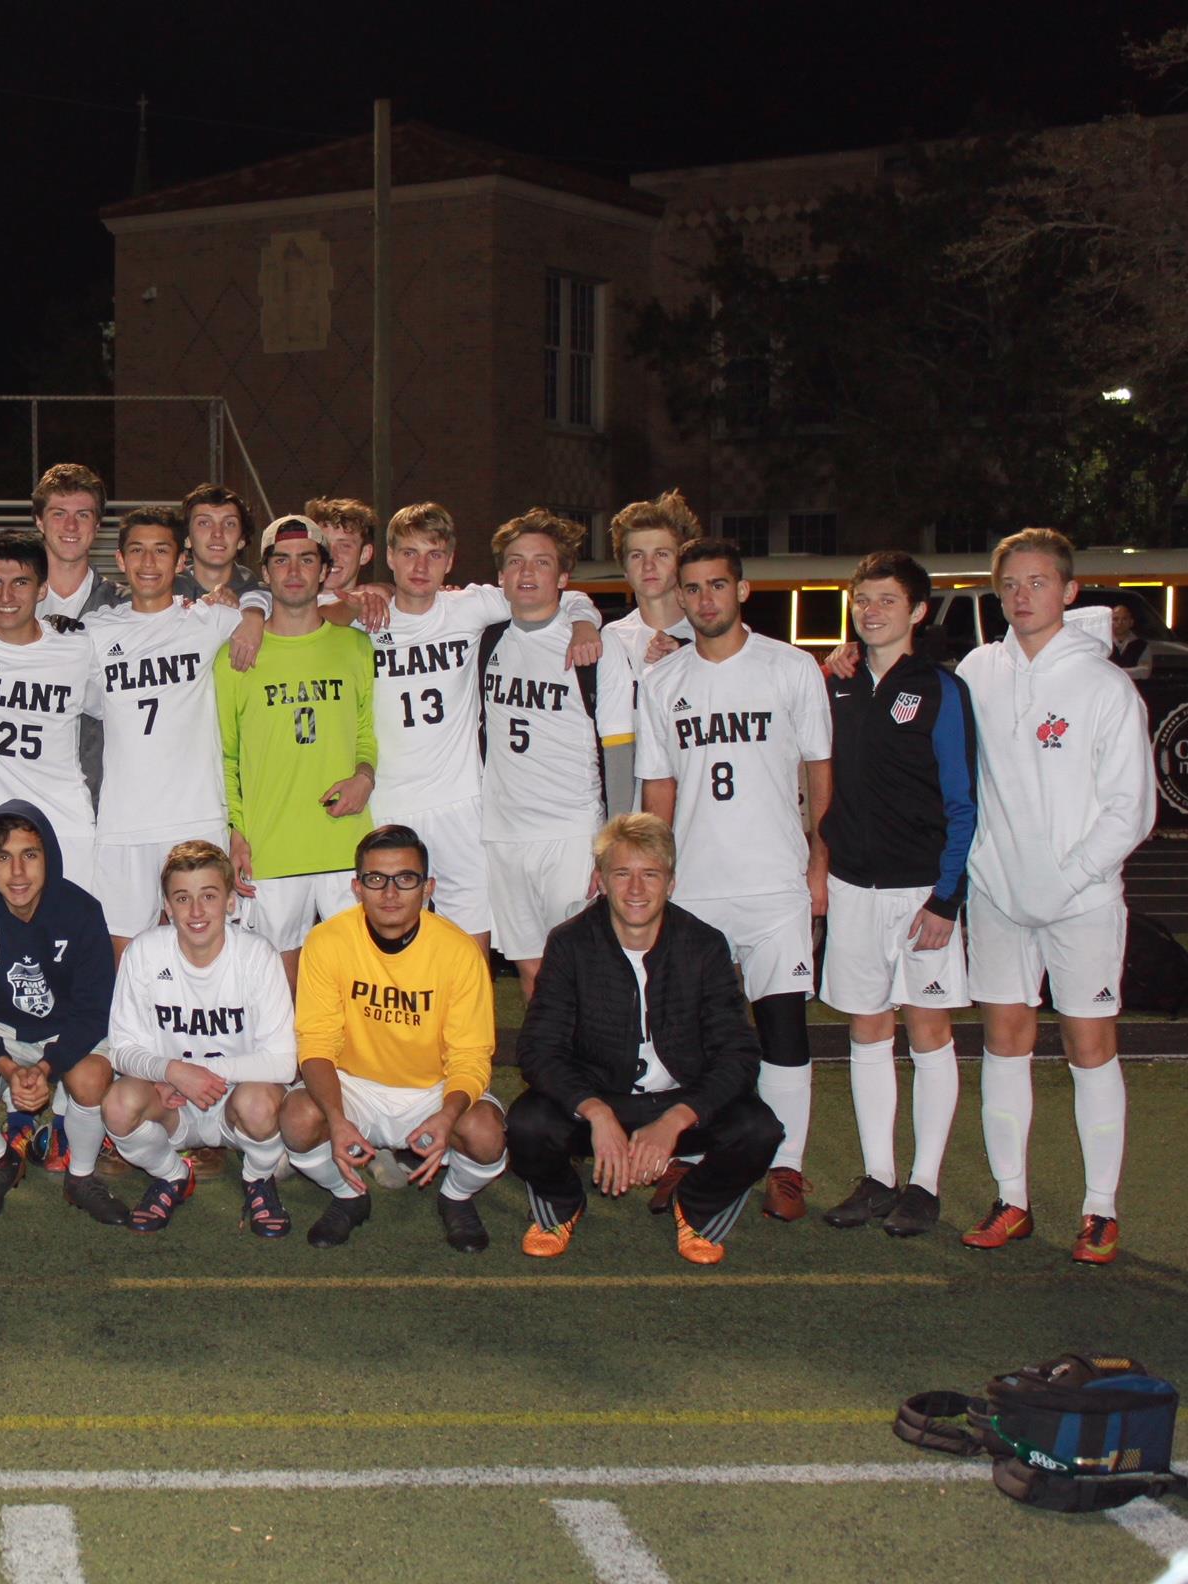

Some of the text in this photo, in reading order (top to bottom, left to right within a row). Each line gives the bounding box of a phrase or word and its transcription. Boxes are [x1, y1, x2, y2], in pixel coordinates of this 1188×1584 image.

[104, 652, 201, 693] PLANT
[374, 639, 469, 678] PLANT
[264, 679, 343, 707] PLANT
[400, 688, 445, 728] 13
[485, 673, 569, 711] PLANT
[897, 692, 920, 706] USA
[137, 698, 159, 735] 7
[675, 711, 772, 750] PLANT
[509, 717, 530, 754] 5
[711, 761, 735, 801] 8
[53, 939, 68, 962] 7
[14, 979, 47, 989] TAMP
[24, 985, 46, 996] BAY
[351, 979, 434, 1013] PLANT
[154, 1004, 245, 1037] PLANT
[364, 1005, 421, 1027] SOCCER
